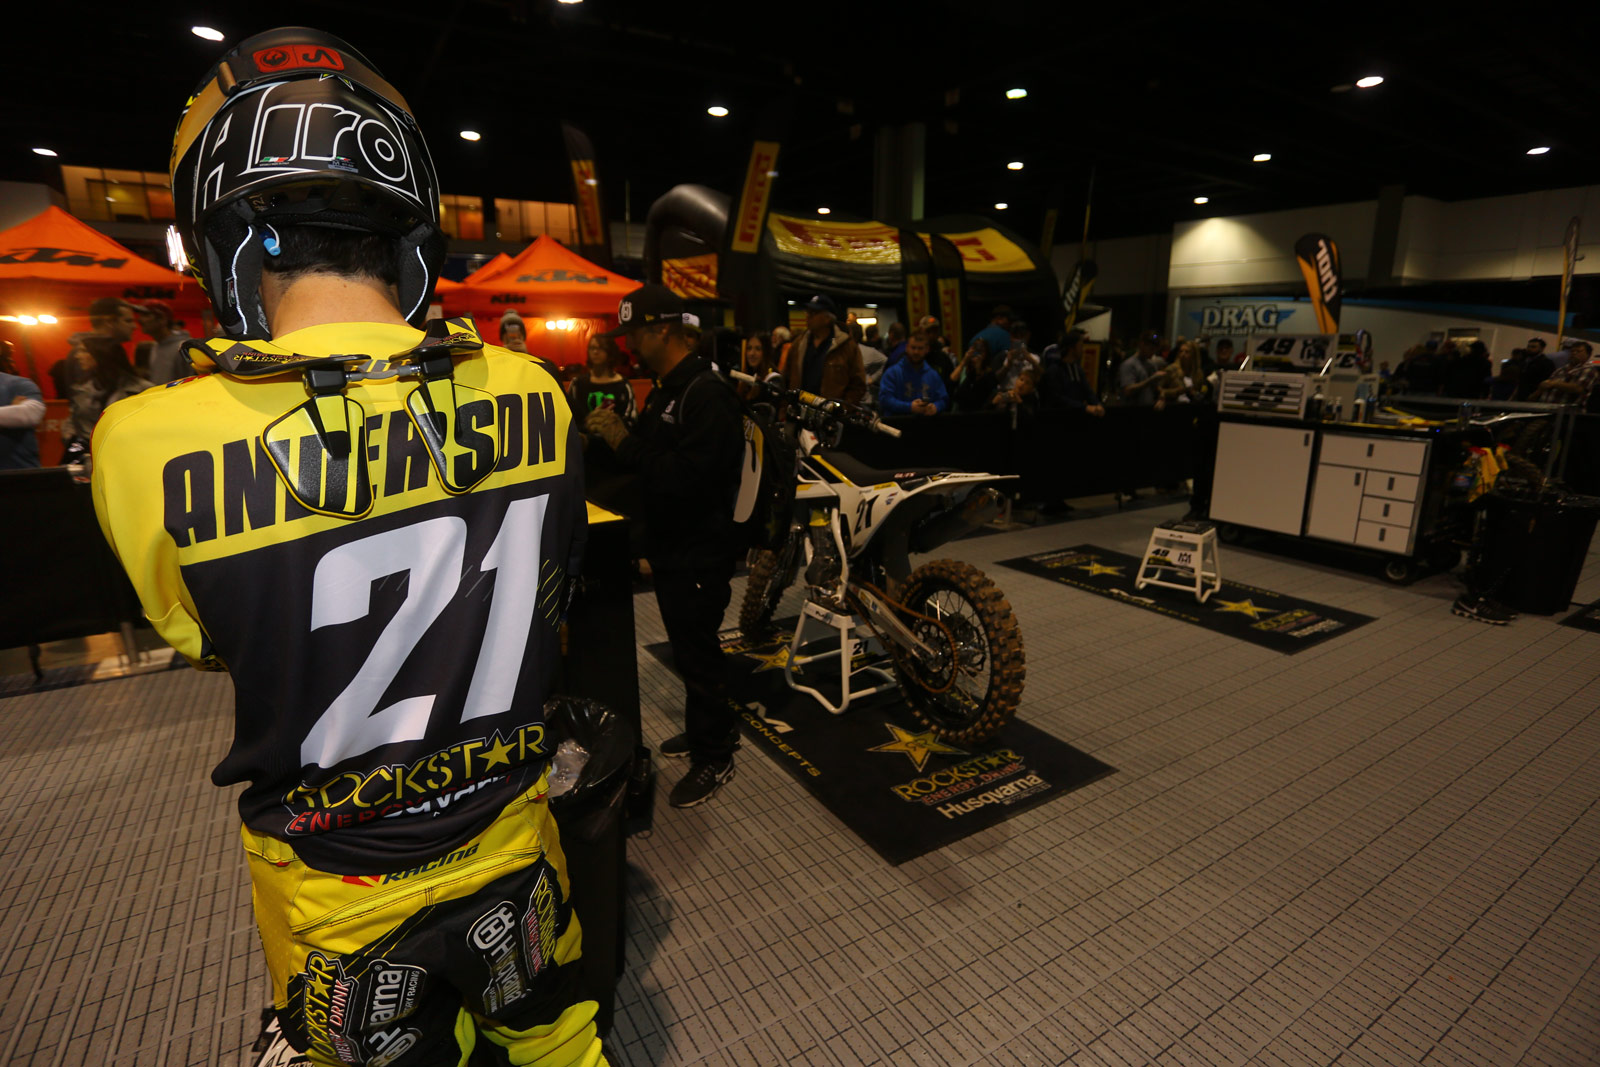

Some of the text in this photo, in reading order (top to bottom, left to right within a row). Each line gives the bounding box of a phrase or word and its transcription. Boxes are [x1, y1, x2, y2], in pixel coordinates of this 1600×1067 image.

[1202, 304, 1279, 328] DRAG
[1257, 338, 1296, 355] 49
[854, 494, 880, 537] 21
[301, 494, 549, 769] 21
[853, 640, 868, 655] 21
[741, 712, 822, 777] CONCEPTS
[936, 772, 1044, 819] Husqvarna
[329, 978, 351, 1027] DRINK
